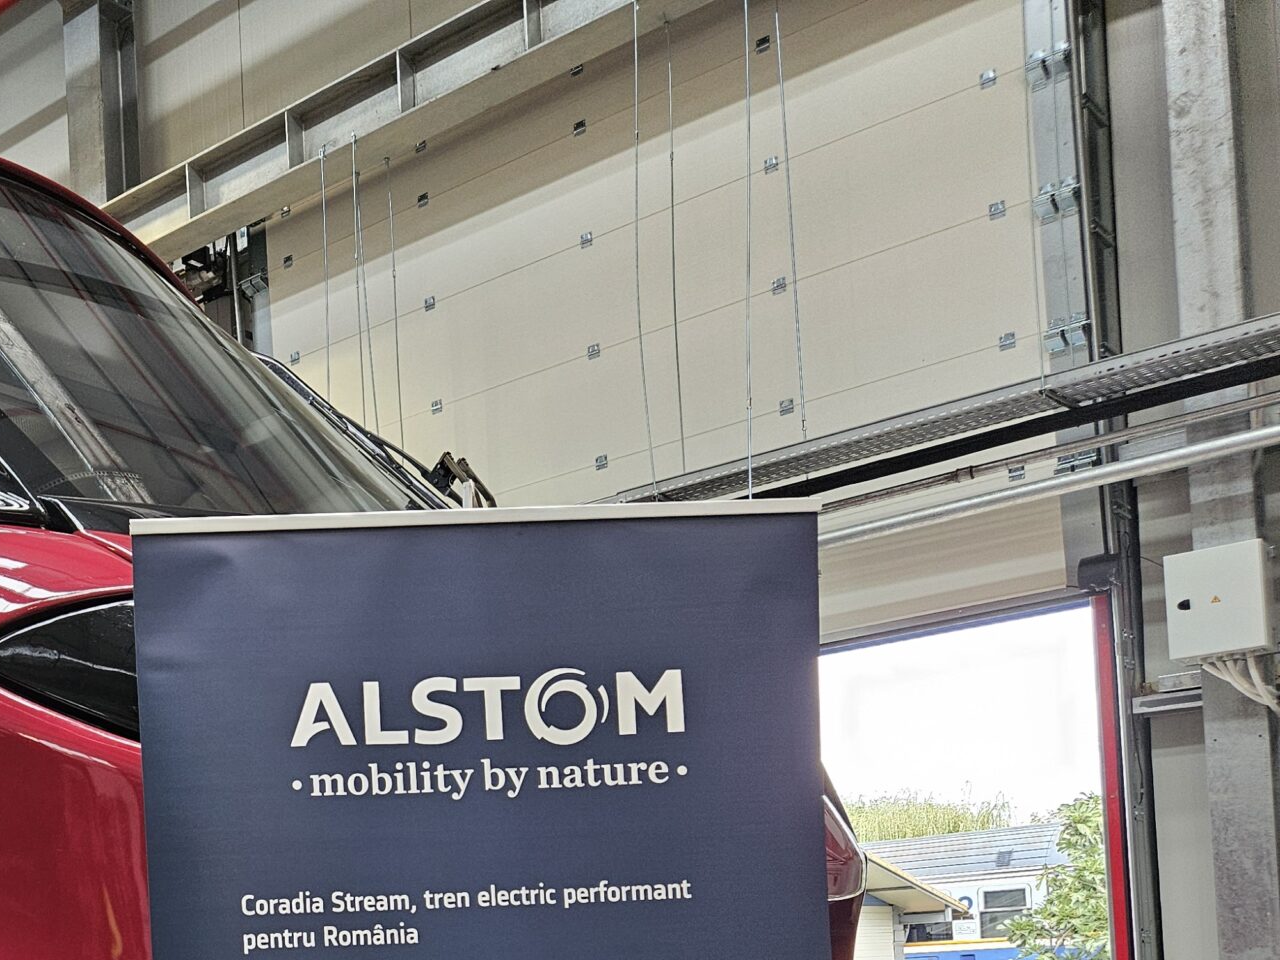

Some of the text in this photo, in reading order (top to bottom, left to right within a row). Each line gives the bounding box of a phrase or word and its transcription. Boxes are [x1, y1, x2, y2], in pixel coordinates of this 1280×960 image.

[291, 668, 684, 747] ALSTOM
[310, 759, 669, 799] mobility by nature
[242, 880, 692, 915] Coradia Stream, tren electric performant
[244, 922, 418, 954] pentru România
